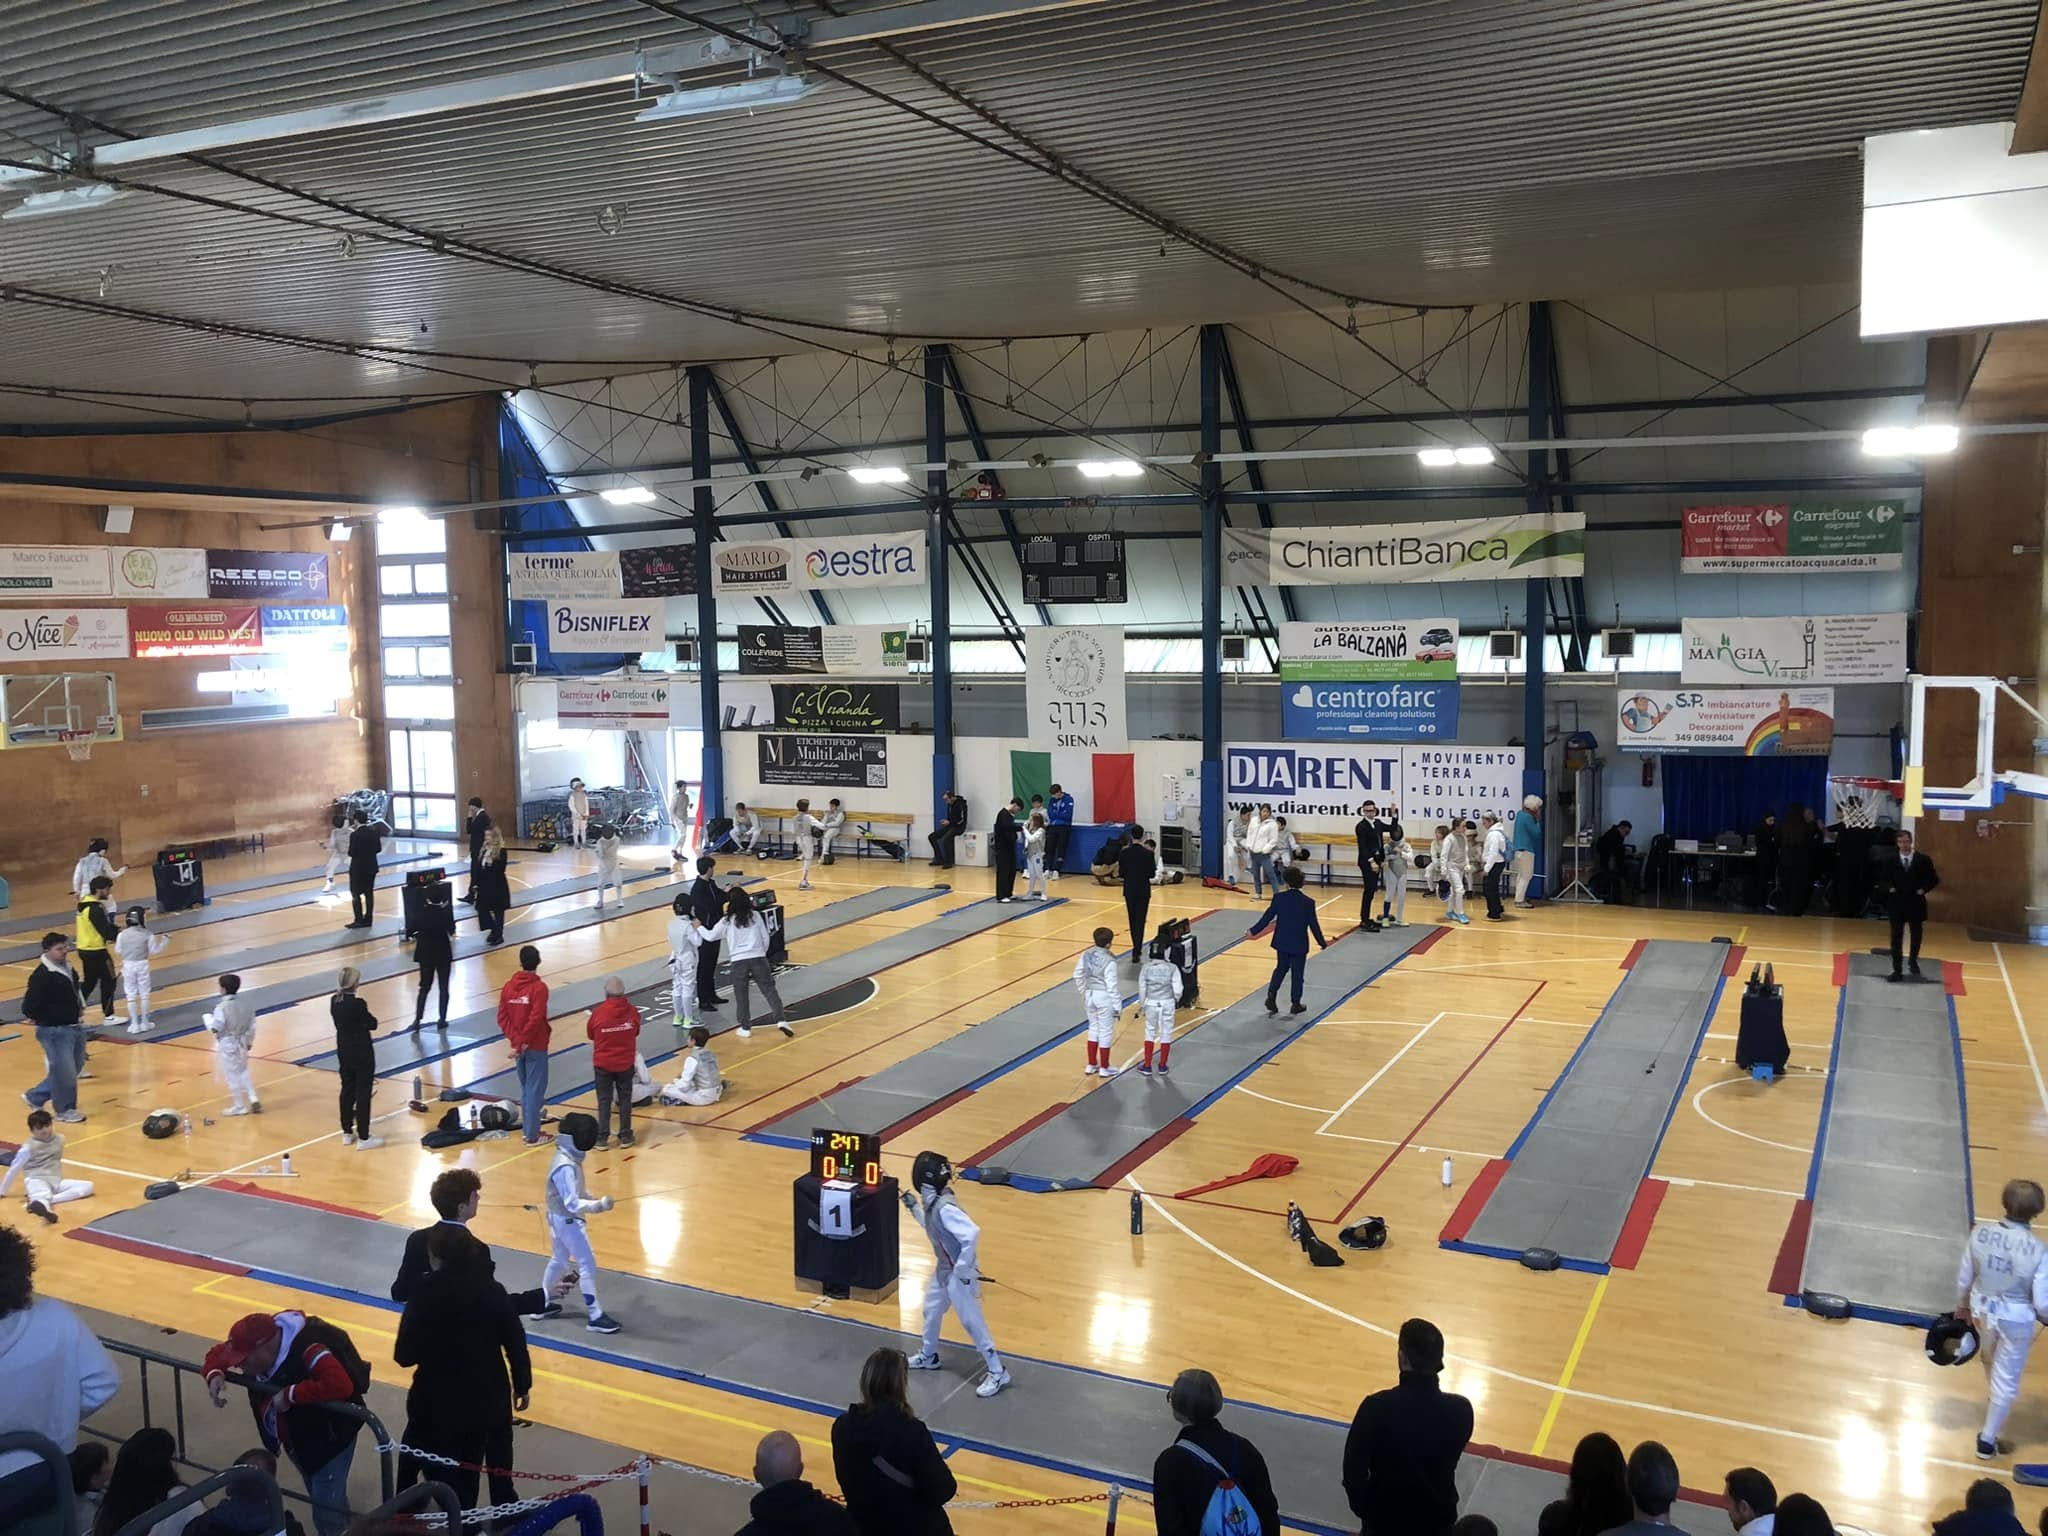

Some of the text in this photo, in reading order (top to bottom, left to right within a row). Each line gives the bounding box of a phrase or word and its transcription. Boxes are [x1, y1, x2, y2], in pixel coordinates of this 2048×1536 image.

[1688, 510, 1752, 524] Carrefour
[1793, 508, 1863, 522] Carrefour
[1717, 523, 1750, 532] market
[726, 550, 780, 566] MARIO
[831, 543, 916, 577] estra
[1238, 551, 1261, 560] BCC
[1283, 537, 1509, 569] ChiantiBanca
[525, 555, 574, 569] terme
[1702, 556, 1878, 569] www.supermercatoacquacalda.it
[725, 571, 782, 581] HAIR STYLIST
[169, 614, 184, 622] OLD
[272, 608, 336, 621] DATTOLI
[7, 615, 61, 651] Nice
[135, 630, 171, 642] NUOVO
[174, 630, 194, 641] OLD
[197, 629, 225, 641] WILD
[227, 628, 257, 640] WEST
[1314, 624, 1407, 632] autoscuola
[1313, 631, 1407, 658] LA BALZANA
[1692, 637, 1704, 647] IL
[742, 648, 784, 657] COLLEVERDE
[559, 690, 594, 700] Carrefour
[612, 690, 648, 700] Carrefour
[806, 684, 876, 717] Veranda
[1316, 684, 1436, 709] centrofarc
[1675, 693, 1771, 710] S.P. Imbiancature
[1316, 709, 1436, 721] professional cleaning solutions
[1698, 712, 1756, 721] Verniciature
[801, 718, 826, 726] PIZZA
[835, 719, 867, 728] CUCINA
[1689, 722, 1744, 732] Decorazioni
[796, 737, 857, 747] ETICHETTIFICIO
[1057, 734, 1098, 748] SIENA
[1675, 733, 1734, 743] 349 0898404
[797, 746, 864, 762] MultiLabel
[1421, 752, 1516, 765] MOVIMENTO
[1229, 755, 1399, 791] DIARENT
[1421, 766, 1472, 779] TERRA
[1423, 785, 1511, 798] EDILIZIA
[1424, 807, 1516, 821] NOLEGIO
[823, 1156, 836, 1179] 0
[865, 1162, 879, 1185] 0
[829, 1204, 842, 1228] 1
[1977, 1227, 2036, 1256] BRUNI
[1987, 1253, 2014, 1276] ITA
